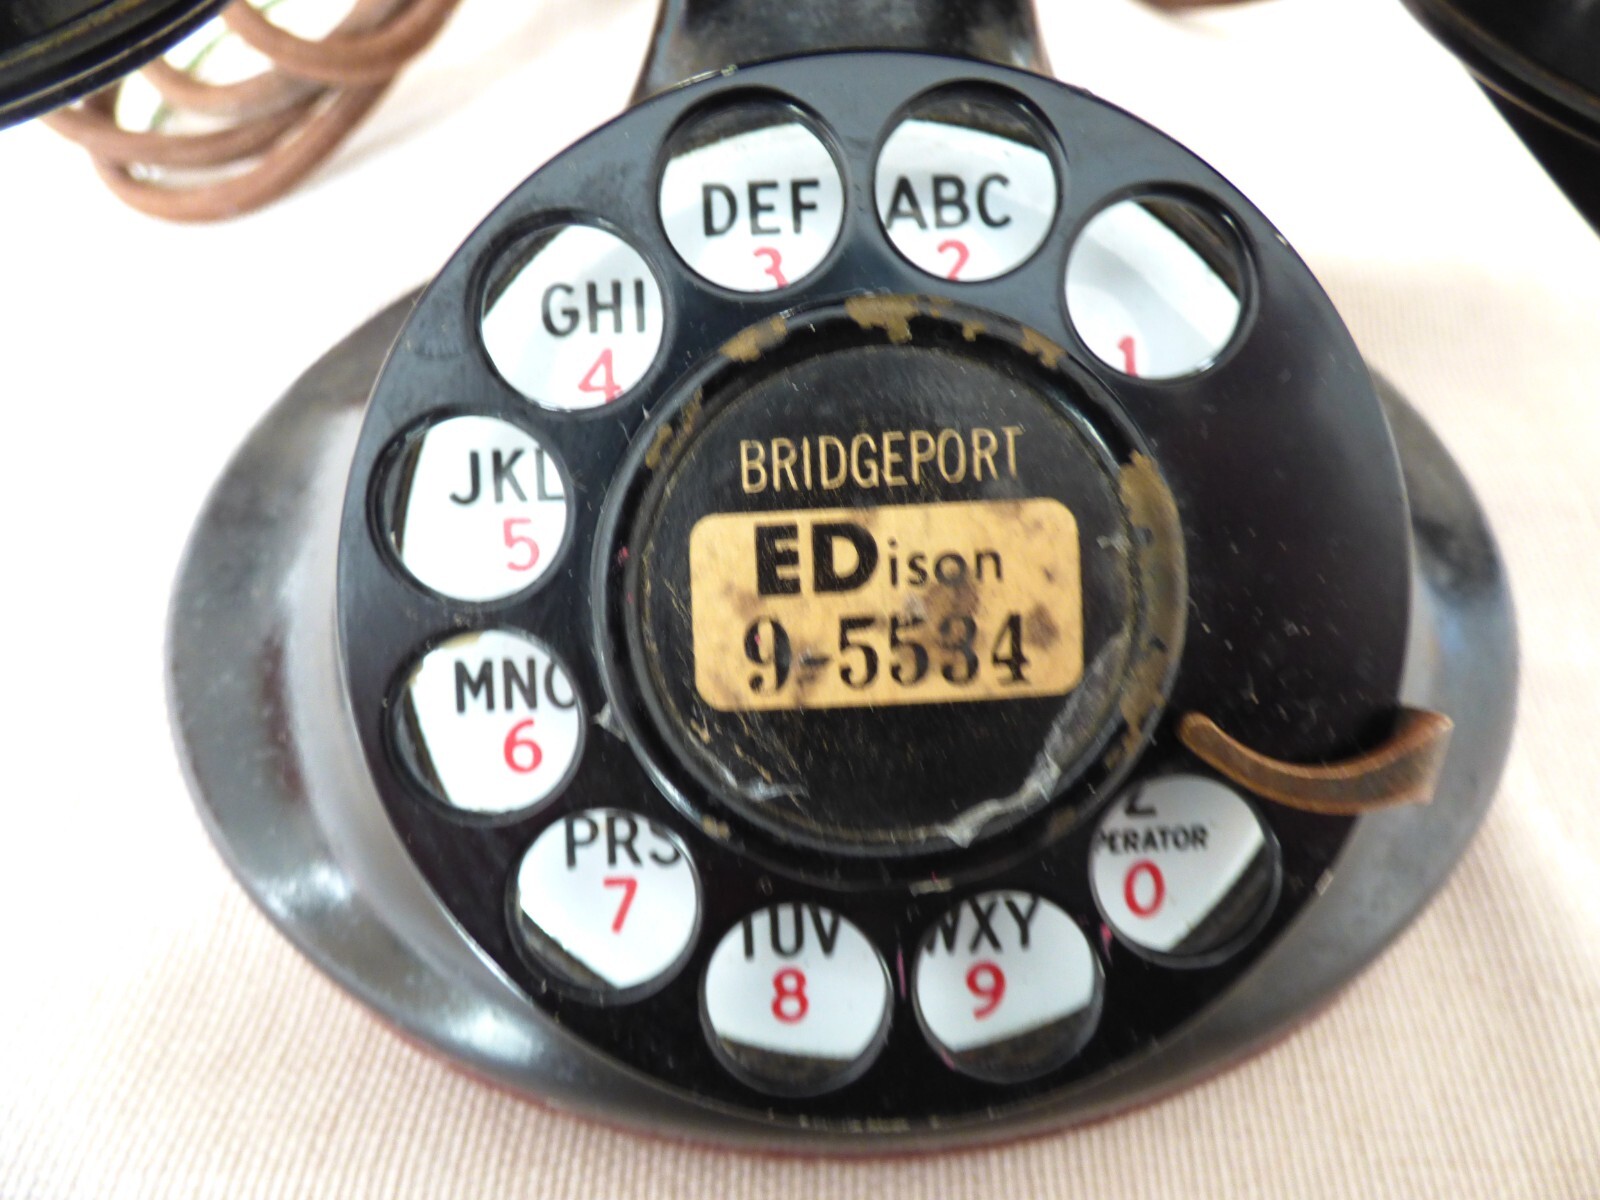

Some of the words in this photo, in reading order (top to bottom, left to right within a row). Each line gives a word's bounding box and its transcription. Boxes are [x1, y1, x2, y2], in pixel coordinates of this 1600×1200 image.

[702, 178, 821, 236] DEF
[886, 172, 1012, 230] ABC
[936, 238, 970, 280] 2
[541, 277, 646, 338] GHI
[577, 347, 624, 404] 4
[1116, 334, 1140, 377] 1
[449, 446, 566, 506] JKL
[739, 426, 1022, 494] BRIDGEPORT
[502, 516, 541, 572] 5
[754, 518, 1003, 598] EDison
[743, 612, 1032, 695] 9-5534
[502, 717, 543, 774] 6
[603, 875, 638, 933] 7
[1123, 858, 1167, 921] 0
[770, 966, 809, 1024] 8
[965, 959, 1007, 1021] 9
